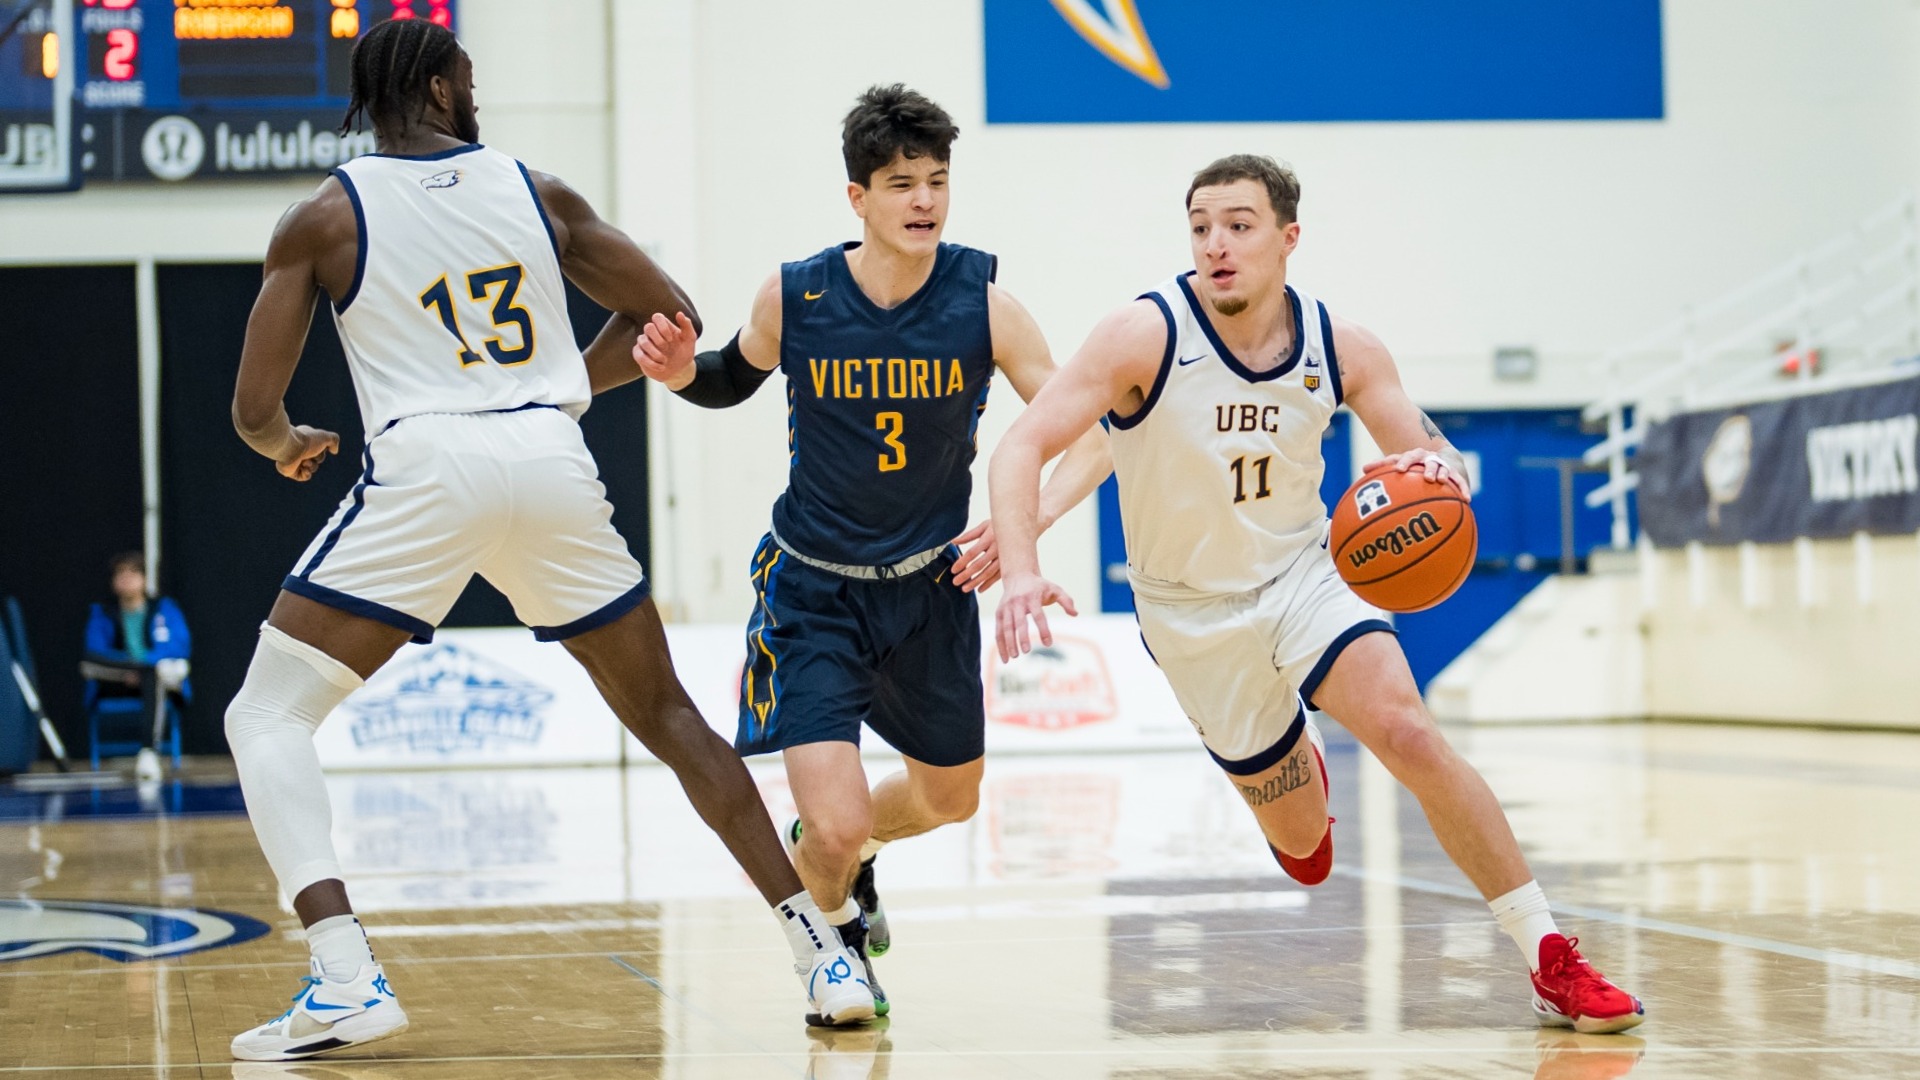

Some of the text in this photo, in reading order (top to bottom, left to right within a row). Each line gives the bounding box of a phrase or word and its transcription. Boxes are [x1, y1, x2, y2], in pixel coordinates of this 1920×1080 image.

[104, 28, 138, 82] 2
[419, 261, 536, 368] 13
[809, 357, 964, 399] VICTORIA
[875, 411, 907, 472] 3
[1215, 404, 1280, 434] UBC
[1230, 454, 1273, 505] 11
[1347, 511, 1443, 569] Wilson
